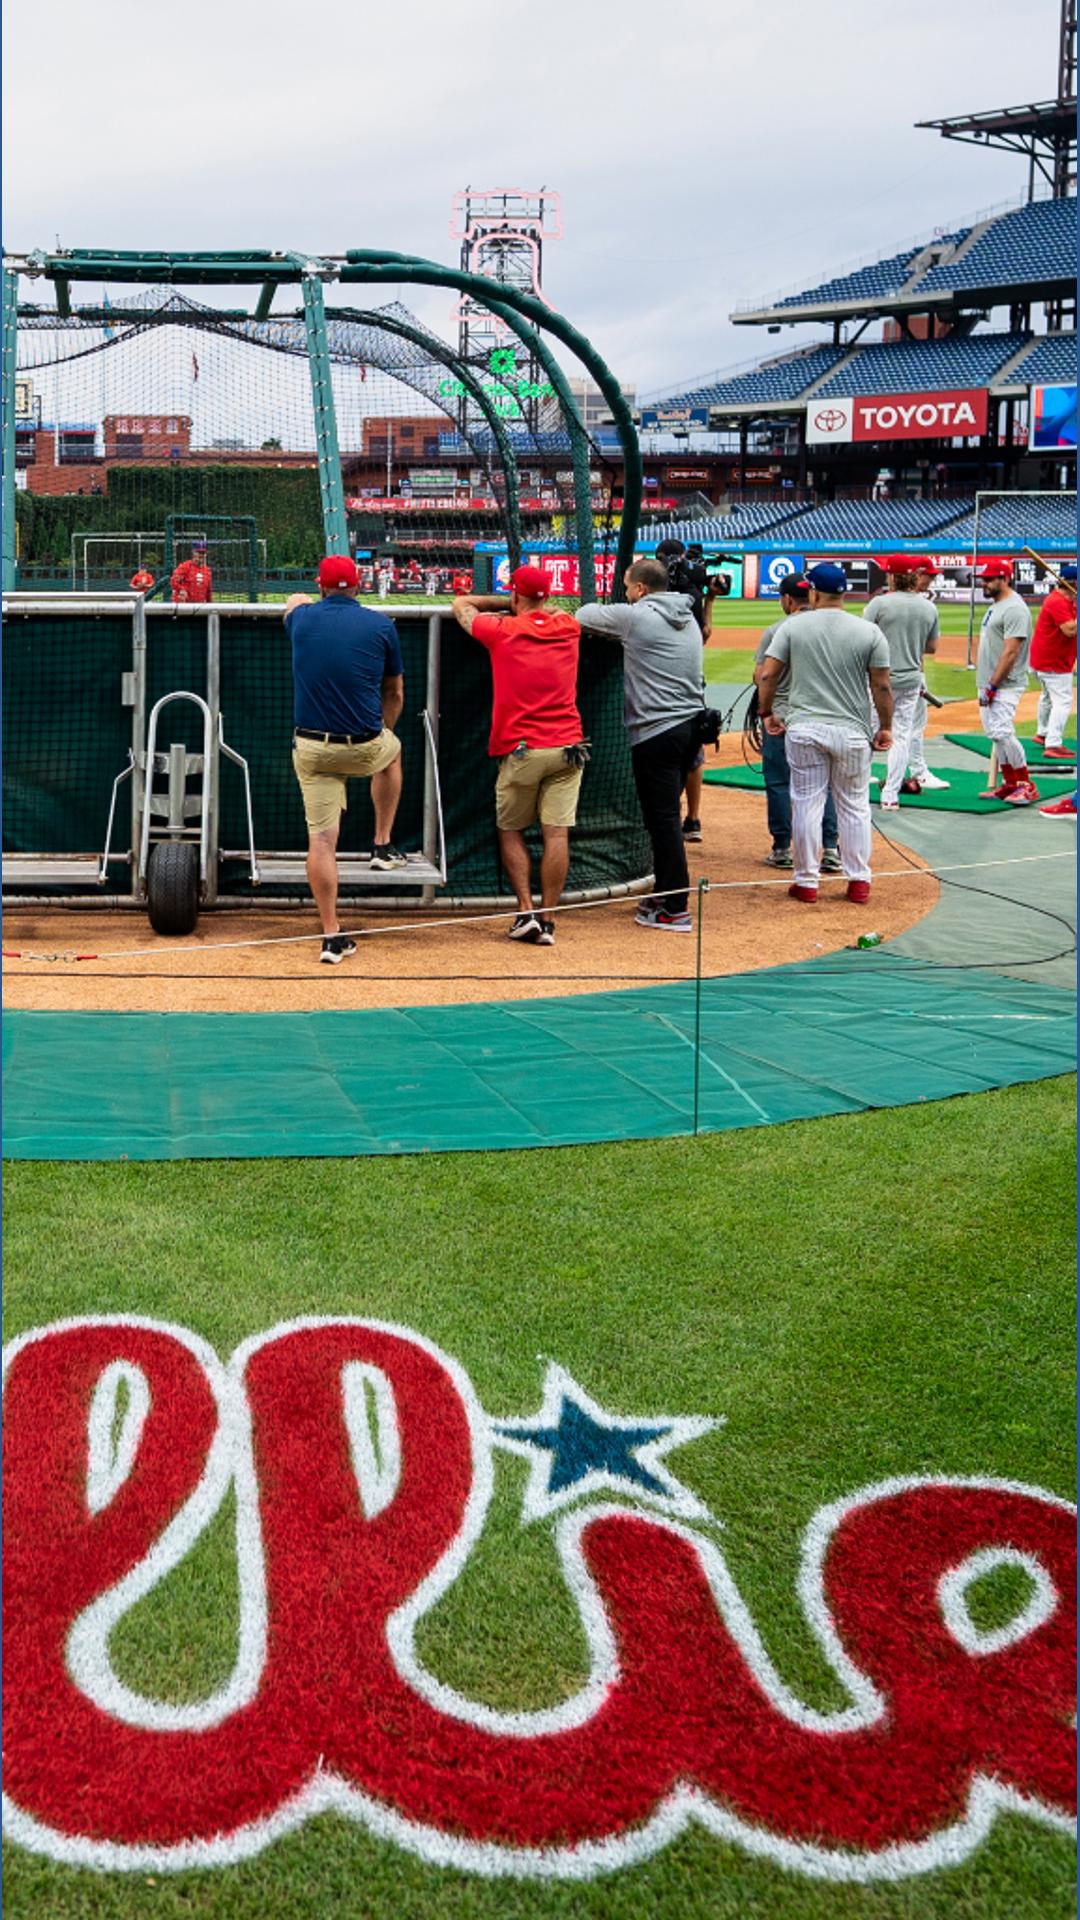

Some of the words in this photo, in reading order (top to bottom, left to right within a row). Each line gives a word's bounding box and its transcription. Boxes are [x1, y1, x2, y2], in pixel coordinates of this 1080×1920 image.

[439, 379, 514, 398] Citens
[859, 401, 976, 430] TOYOTA
[544, 559, 570, 592] T
